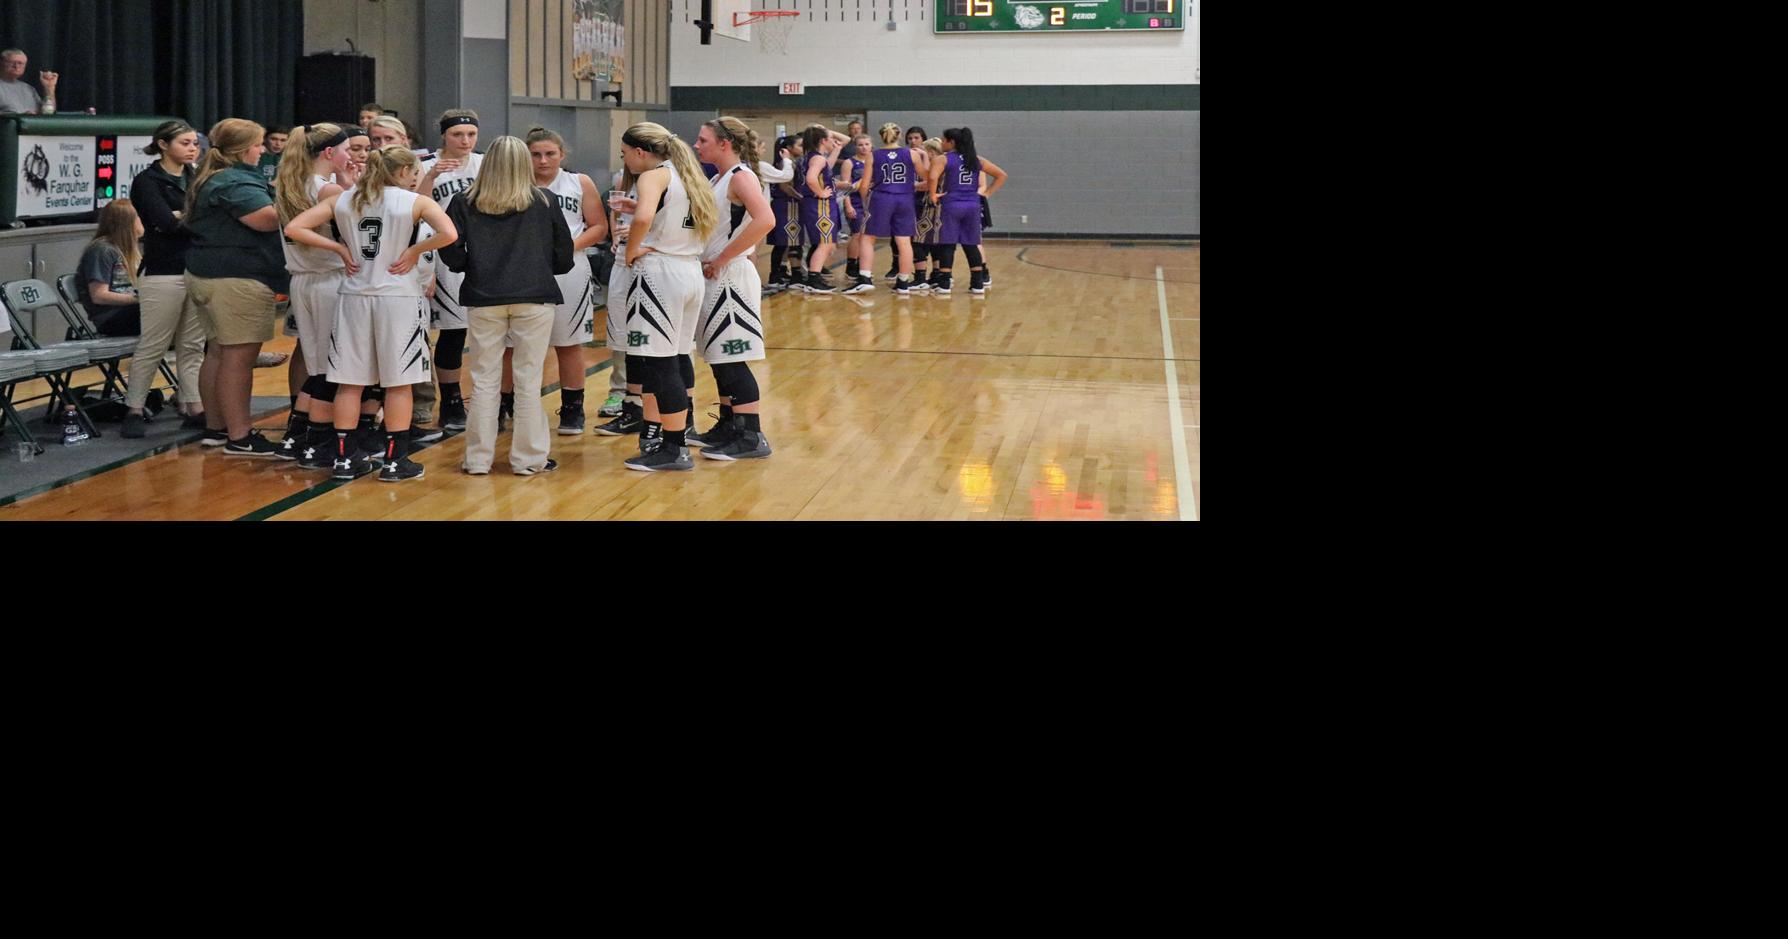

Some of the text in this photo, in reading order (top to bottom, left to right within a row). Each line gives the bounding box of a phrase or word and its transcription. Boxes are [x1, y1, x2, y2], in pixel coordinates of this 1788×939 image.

[1050, 7, 1065, 25] 2
[783, 82, 801, 94] EXIT
[59, 142, 84, 151] Welcome
[70, 154, 79, 162] the
[98, 154, 114, 165] POSS
[59, 163, 84, 177] W. G.
[881, 162, 907, 184] 12
[958, 164, 973, 185] 2
[50, 179, 89, 196] Farquhar
[45, 196, 69, 208] Events
[70, 195, 92, 207] Center
[358, 216, 383, 260] 3
